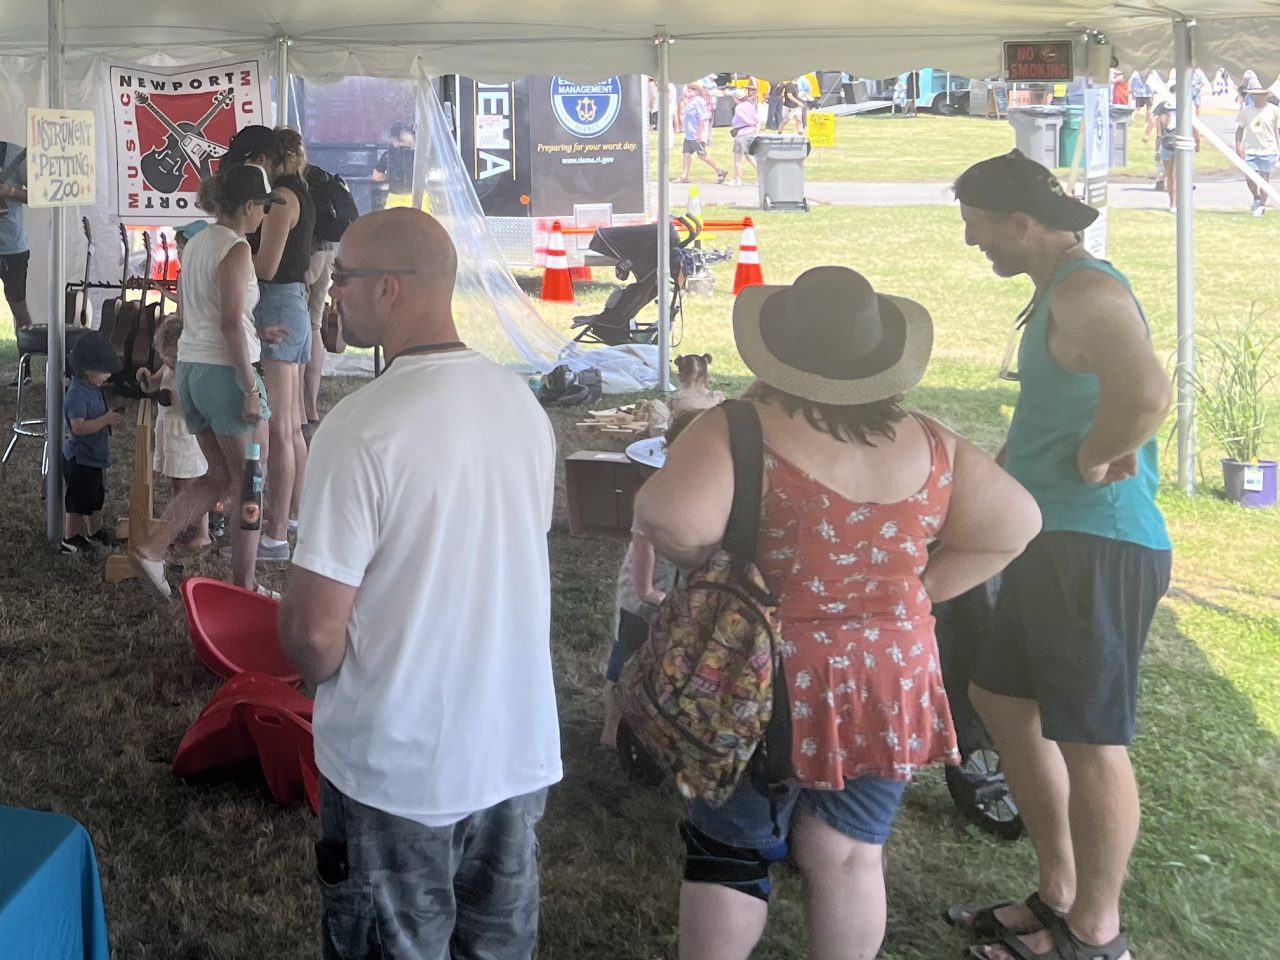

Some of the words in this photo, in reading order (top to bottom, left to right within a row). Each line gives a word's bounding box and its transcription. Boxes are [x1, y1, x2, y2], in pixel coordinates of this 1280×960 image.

[1017, 46, 1034, 61] NO
[1010, 63, 1067, 78] SMOKING
[120, 72, 234, 91] NEWPORT
[558, 85, 613, 94] MANAGEMENT
[537, 143, 572, 154] Preparing
[573, 142, 583, 152] for
[584, 143, 601, 153] your
[602, 142, 622, 151] worst
[40, 152, 90, 177] PETTING
[561, 155, 614, 165] www.riema.ri.gov
